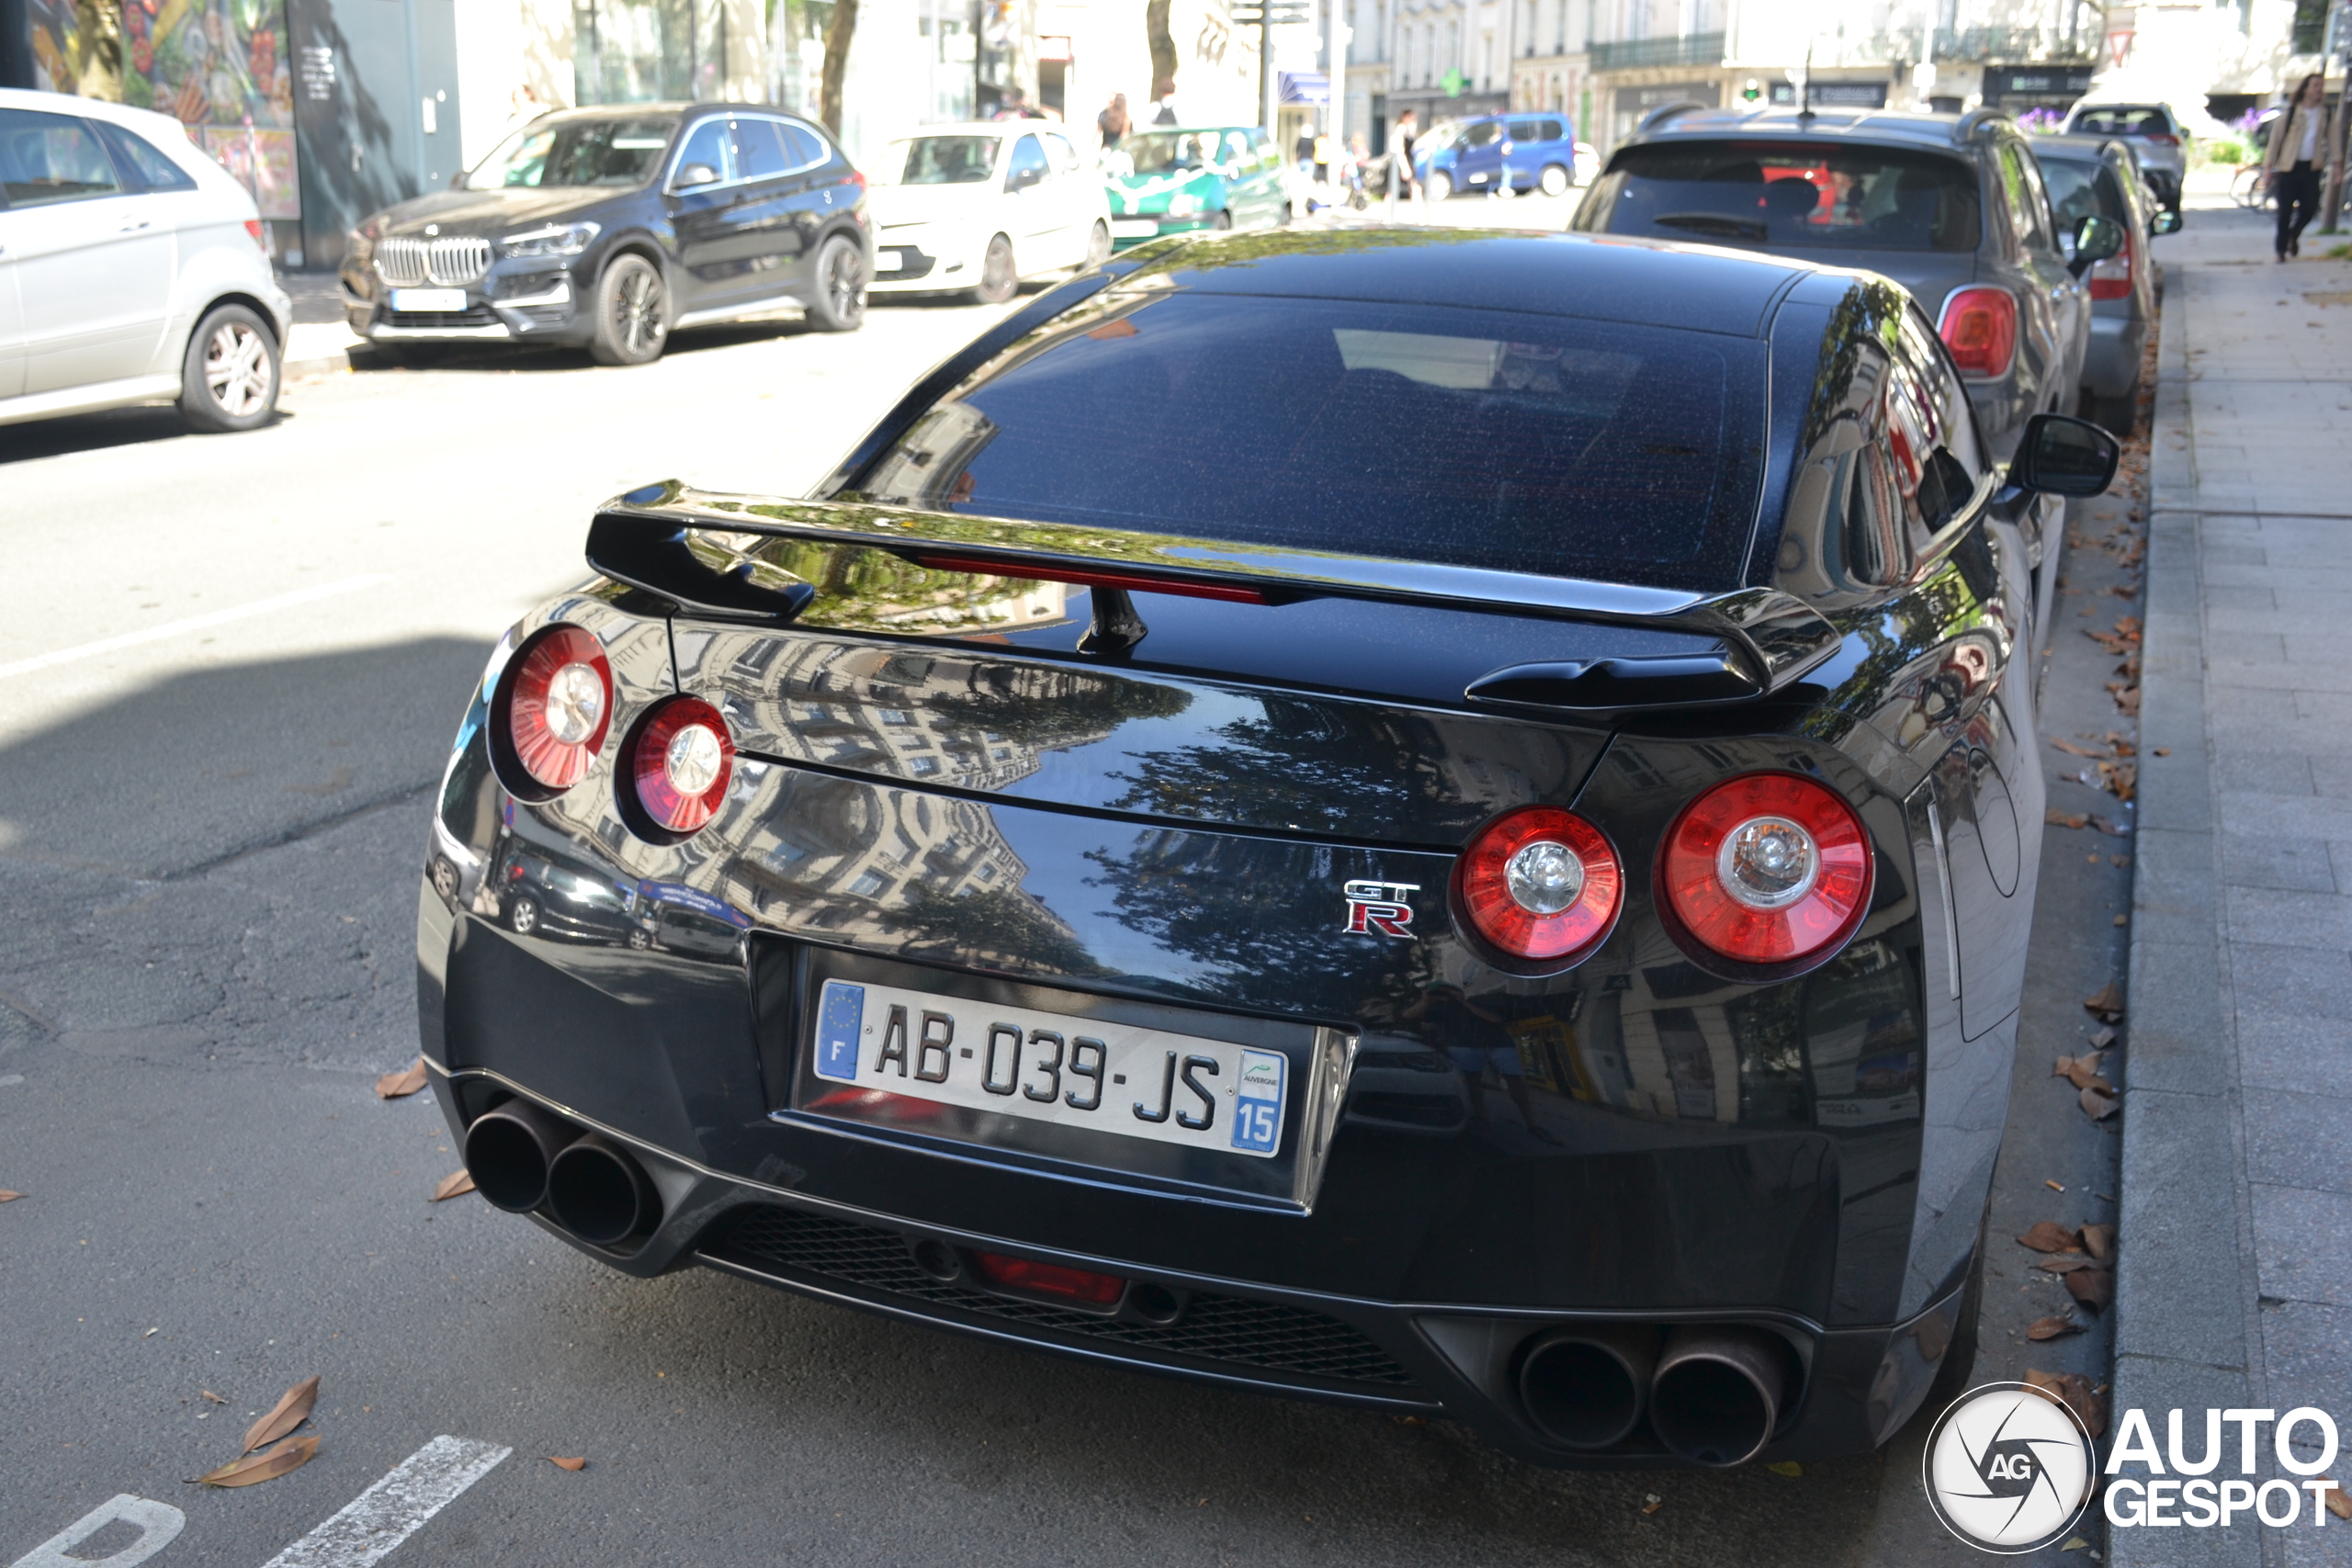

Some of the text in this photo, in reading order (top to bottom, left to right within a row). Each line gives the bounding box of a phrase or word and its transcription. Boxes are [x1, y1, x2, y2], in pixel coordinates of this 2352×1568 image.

[831, 1041, 846, 1062] F
[874, 1003, 1220, 1132] AB-039-JS
[1243, 1075, 1278, 1087] AUVERGNE
[1238, 1102, 1275, 1143] 15
